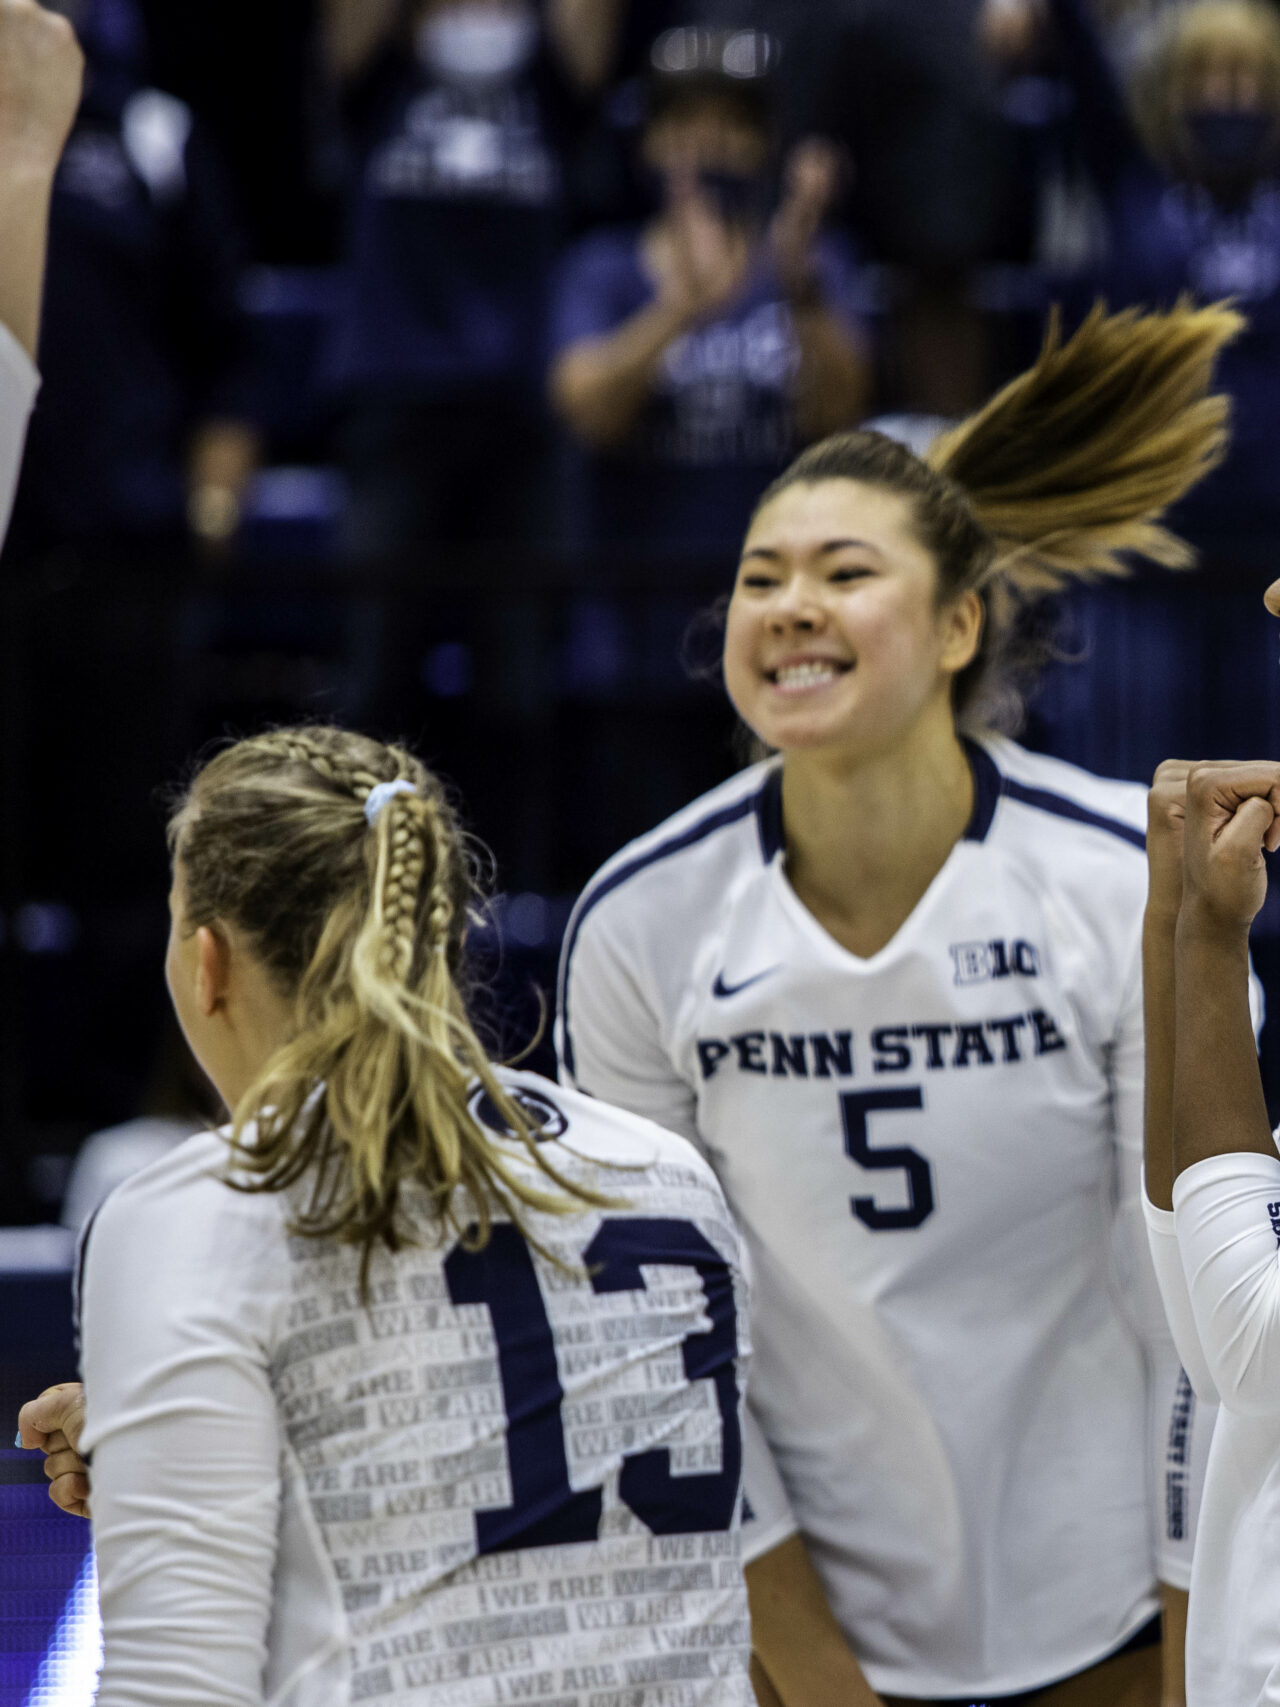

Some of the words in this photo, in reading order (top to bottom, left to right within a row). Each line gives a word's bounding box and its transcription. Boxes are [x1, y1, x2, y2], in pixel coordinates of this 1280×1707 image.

[698, 1031, 854, 1080] PENN
[871, 1008, 1066, 1073] STATE
[838, 1085, 934, 1232] 5
[441, 1216, 740, 1556] 13
